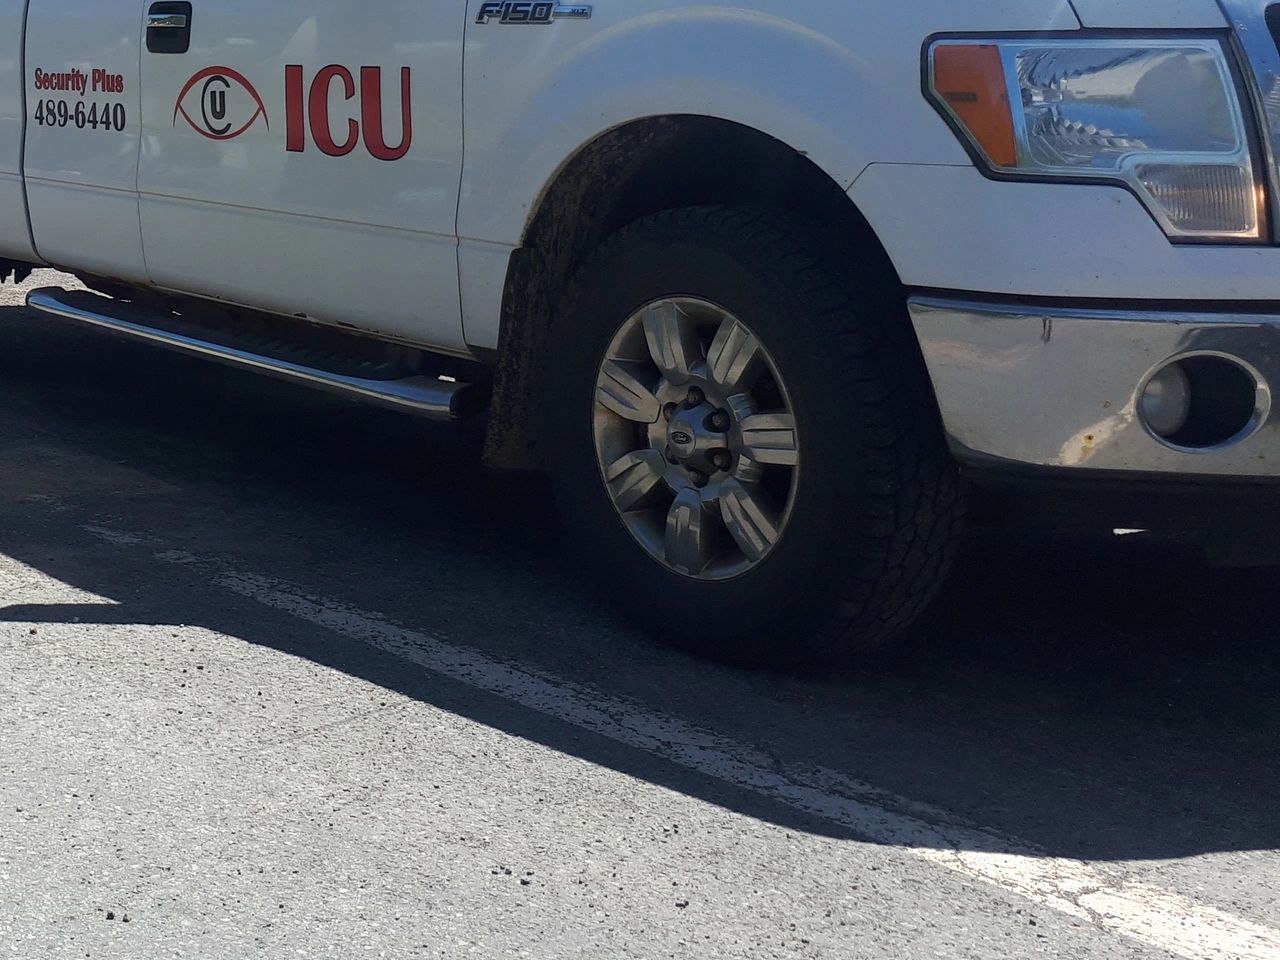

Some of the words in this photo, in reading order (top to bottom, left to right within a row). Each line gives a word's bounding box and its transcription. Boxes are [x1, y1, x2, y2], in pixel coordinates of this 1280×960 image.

[34, 67, 88, 96] Security
[91, 68, 124, 93] Plus
[34, 99, 126, 132] 489-6440
[284, 64, 412, 161] ICU
